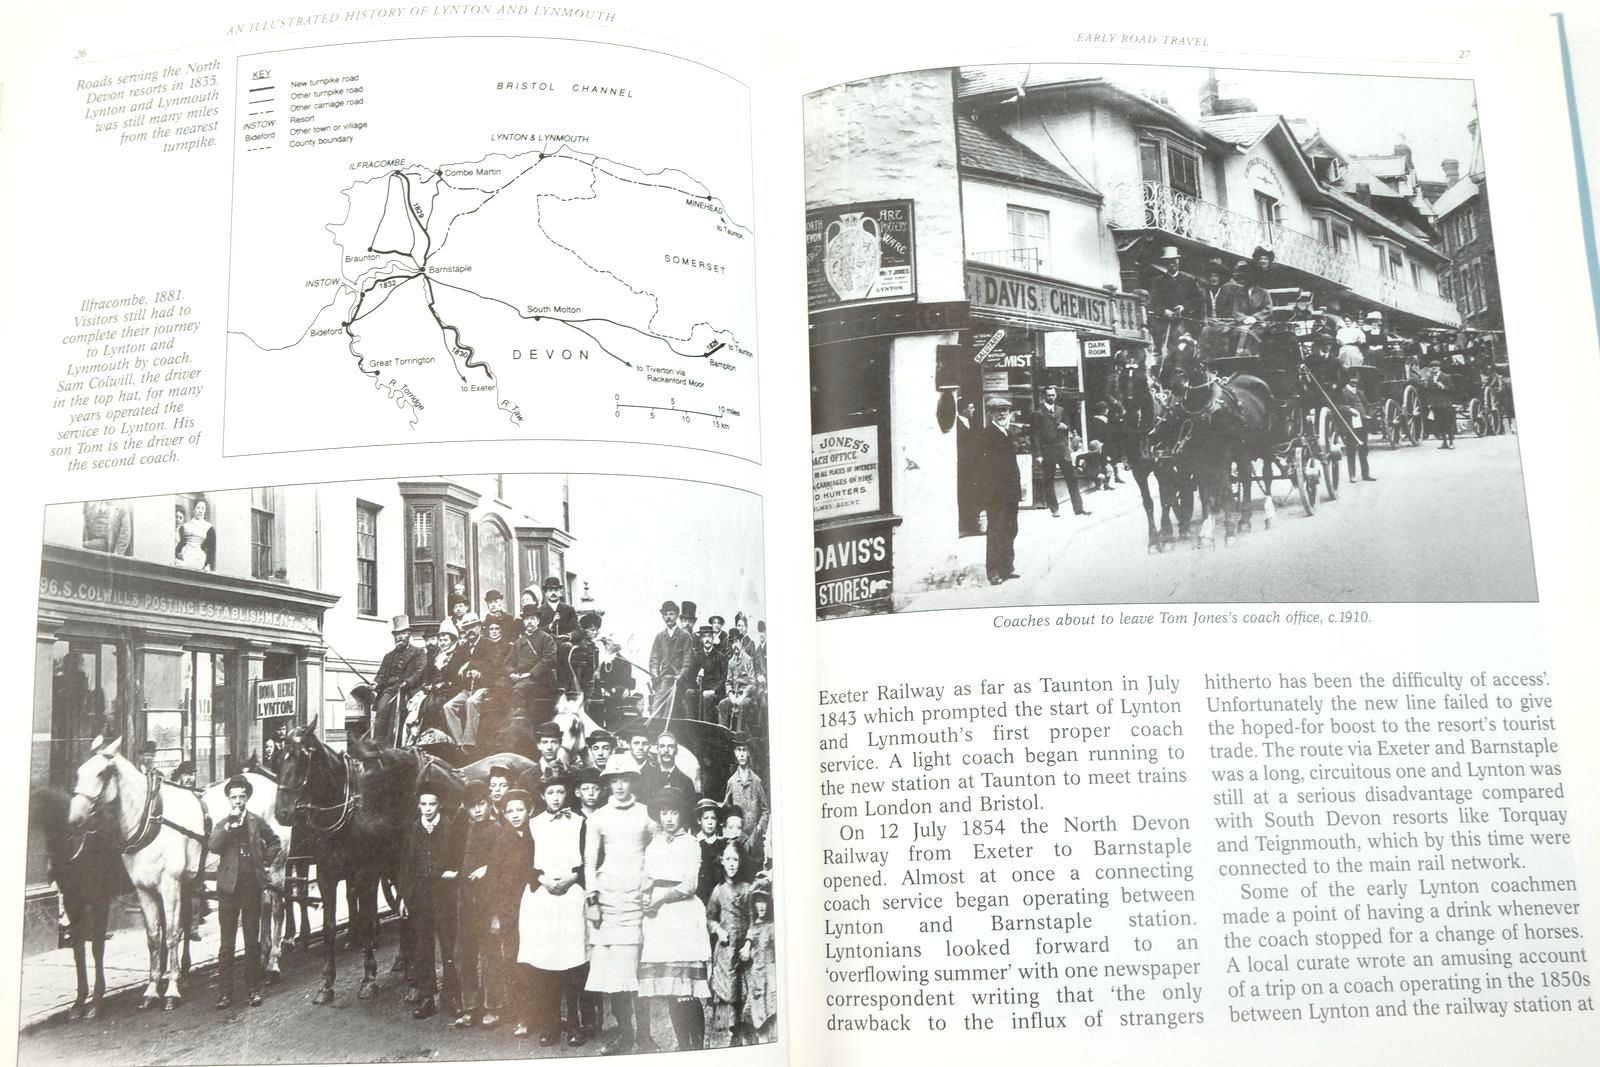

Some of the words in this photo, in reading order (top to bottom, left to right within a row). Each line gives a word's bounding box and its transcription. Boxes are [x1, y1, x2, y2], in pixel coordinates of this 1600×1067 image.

[226, 24, 245, 36] AN
[250, 12, 340, 33] ILLUSTRATED
[344, 8, 406, 22] HISTORY
[410, 6, 430, 17] OF
[433, 4, 493, 15] LYNTON
[496, 4, 528, 15] AND
[534, 6, 616, 23] LYNMOUTH
[1076, 33, 1117, 43] EARLY
[1121, 34, 1157, 44] ROAD
[1163, 36, 1209, 47] TRAVEL
[74, 49, 87, 59] 26
[1458, 49, 1471, 60] 27
[76, 76, 113, 91] Roads
[117, 71, 159, 85] serving
[162, 66, 182, 78] the
[186, 59, 220, 75] North
[252, 69, 271, 79] KEY
[310, 78, 340, 86] turnpike
[86, 91, 125, 104] Devon
[129, 84, 168, 97] resorts
[172, 79, 185, 90] in
[190, 75, 219, 89] 1835.
[314, 89, 344, 98] turnpike
[346, 86, 363, 94] road
[497, 82, 554, 91] BRISTOL
[572, 84, 632, 98] CHANNEL
[243, 120, 276, 130] INSTOW
[290, 115, 315, 124] Resort
[290, 128, 311, 136] Other
[344, 122, 368, 130] village
[245, 132, 275, 142] Bideford
[289, 140, 316, 148] County
[318, 136, 354, 145] boundary
[530, 134, 536, 142] &
[538, 134, 590, 143] LYNMOUTH
[349, 158, 406, 171] ILFRACOMBE
[444, 169, 473, 178] Combe
[475, 168, 502, 177] Martin
[413, 202, 425, 219] 1829
[686, 199, 724, 215] MINEHEAD
[345, 252, 381, 264] Braunton
[664, 254, 726, 275] SOMERSET
[428, 264, 473, 275] Barnstaple
[305, 278, 341, 288] INSTOW
[379, 280, 397, 290] 1832
[80, 294, 148, 313] Ilfracombe,
[154, 289, 184, 303] 1881.
[1050, 289, 1107, 323] CHEMIST
[554, 306, 581, 314] Molton
[310, 326, 343, 338] Bideford
[451, 346, 468, 359] 1830
[513, 349, 589, 360] DEVON
[67, 358, 130, 378] Lynmouth
[134, 356, 149, 371] by
[153, 352, 192, 367] coach.
[369, 359, 392, 368] Great
[395, 356, 436, 368] Torrington
[709, 358, 737, 372] Bampton
[646, 365, 674, 375] Tiverton
[676, 369, 686, 377] via
[57, 381, 84, 393] Sam
[89, 373, 135, 389] Colwill,
[141, 371, 161, 384] the
[165, 369, 202, 382] driver
[647, 375, 687, 386] Rackenford
[388, 378, 397, 388] R.
[400, 382, 425, 411] Torridge
[461, 385, 469, 393] to
[470, 384, 496, 393] Exeter
[500, 399, 510, 409] R.
[509, 404, 525, 422] Taw
[614, 393, 620, 401] 0
[670, 397, 676, 405] 5
[718, 405, 726, 413] 10
[726, 407, 741, 417] miles
[615, 410, 621, 418] 0
[650, 412, 655, 420] 5
[682, 416, 691, 424] 10
[712, 421, 720, 429] 15
[720, 422, 731, 430] km
[144, 593, 195, 614] POSTING
[993, 614, 1050, 628] Coaches
[1056, 613, 1095, 626] about
[1101, 614, 1114, 625] to
[1120, 612, 1154, 625] leave
[1160, 612, 1187, 624] Tom
[1243, 611, 1280, 624] coach
[1286, 610, 1323, 625] office,
[1328, 611, 1371, 623] c.1910.
[1205, 674, 1272, 690] hitherto
[1279, 673, 1307, 689] has
[1312, 673, 1352, 689] been
[1360, 672, 1385, 688] the
[1392, 672, 1463, 691] difficulty
[1470, 671, 1487, 687] of
[258, 684, 276, 700] BOOK
[276, 682, 295, 698] HERE
[819, 690, 869, 706] Exeter
[877, 683, 945, 701] Railway
[954, 685, 972, 696] as
[981, 679, 1005, 695] far
[1014, 682, 1032, 694] as
[1040, 678, 1113, 693] Taunton
[1122, 676, 1140, 692] in
[1148, 674, 1180, 695] July
[1215, 812, 1253, 828] with
[1265, 810, 1314, 828] South
[1326, 811, 1381, 826] Devon
[1393, 810, 1448, 825] resorts
[1459, 807, 1489, 823] like
[1499, 807, 1568, 826] Torquay
[1229, 1006, 1303, 1023] between
[1308, 1003, 1370, 1024] Lynton
[1376, 1000, 1408, 1017] and
[1413, 999, 1440, 1016] the
[1446, 997, 1508, 1018] railway
[1513, 998, 1573, 1013] station
[1578, 996, 1595, 1011] at
